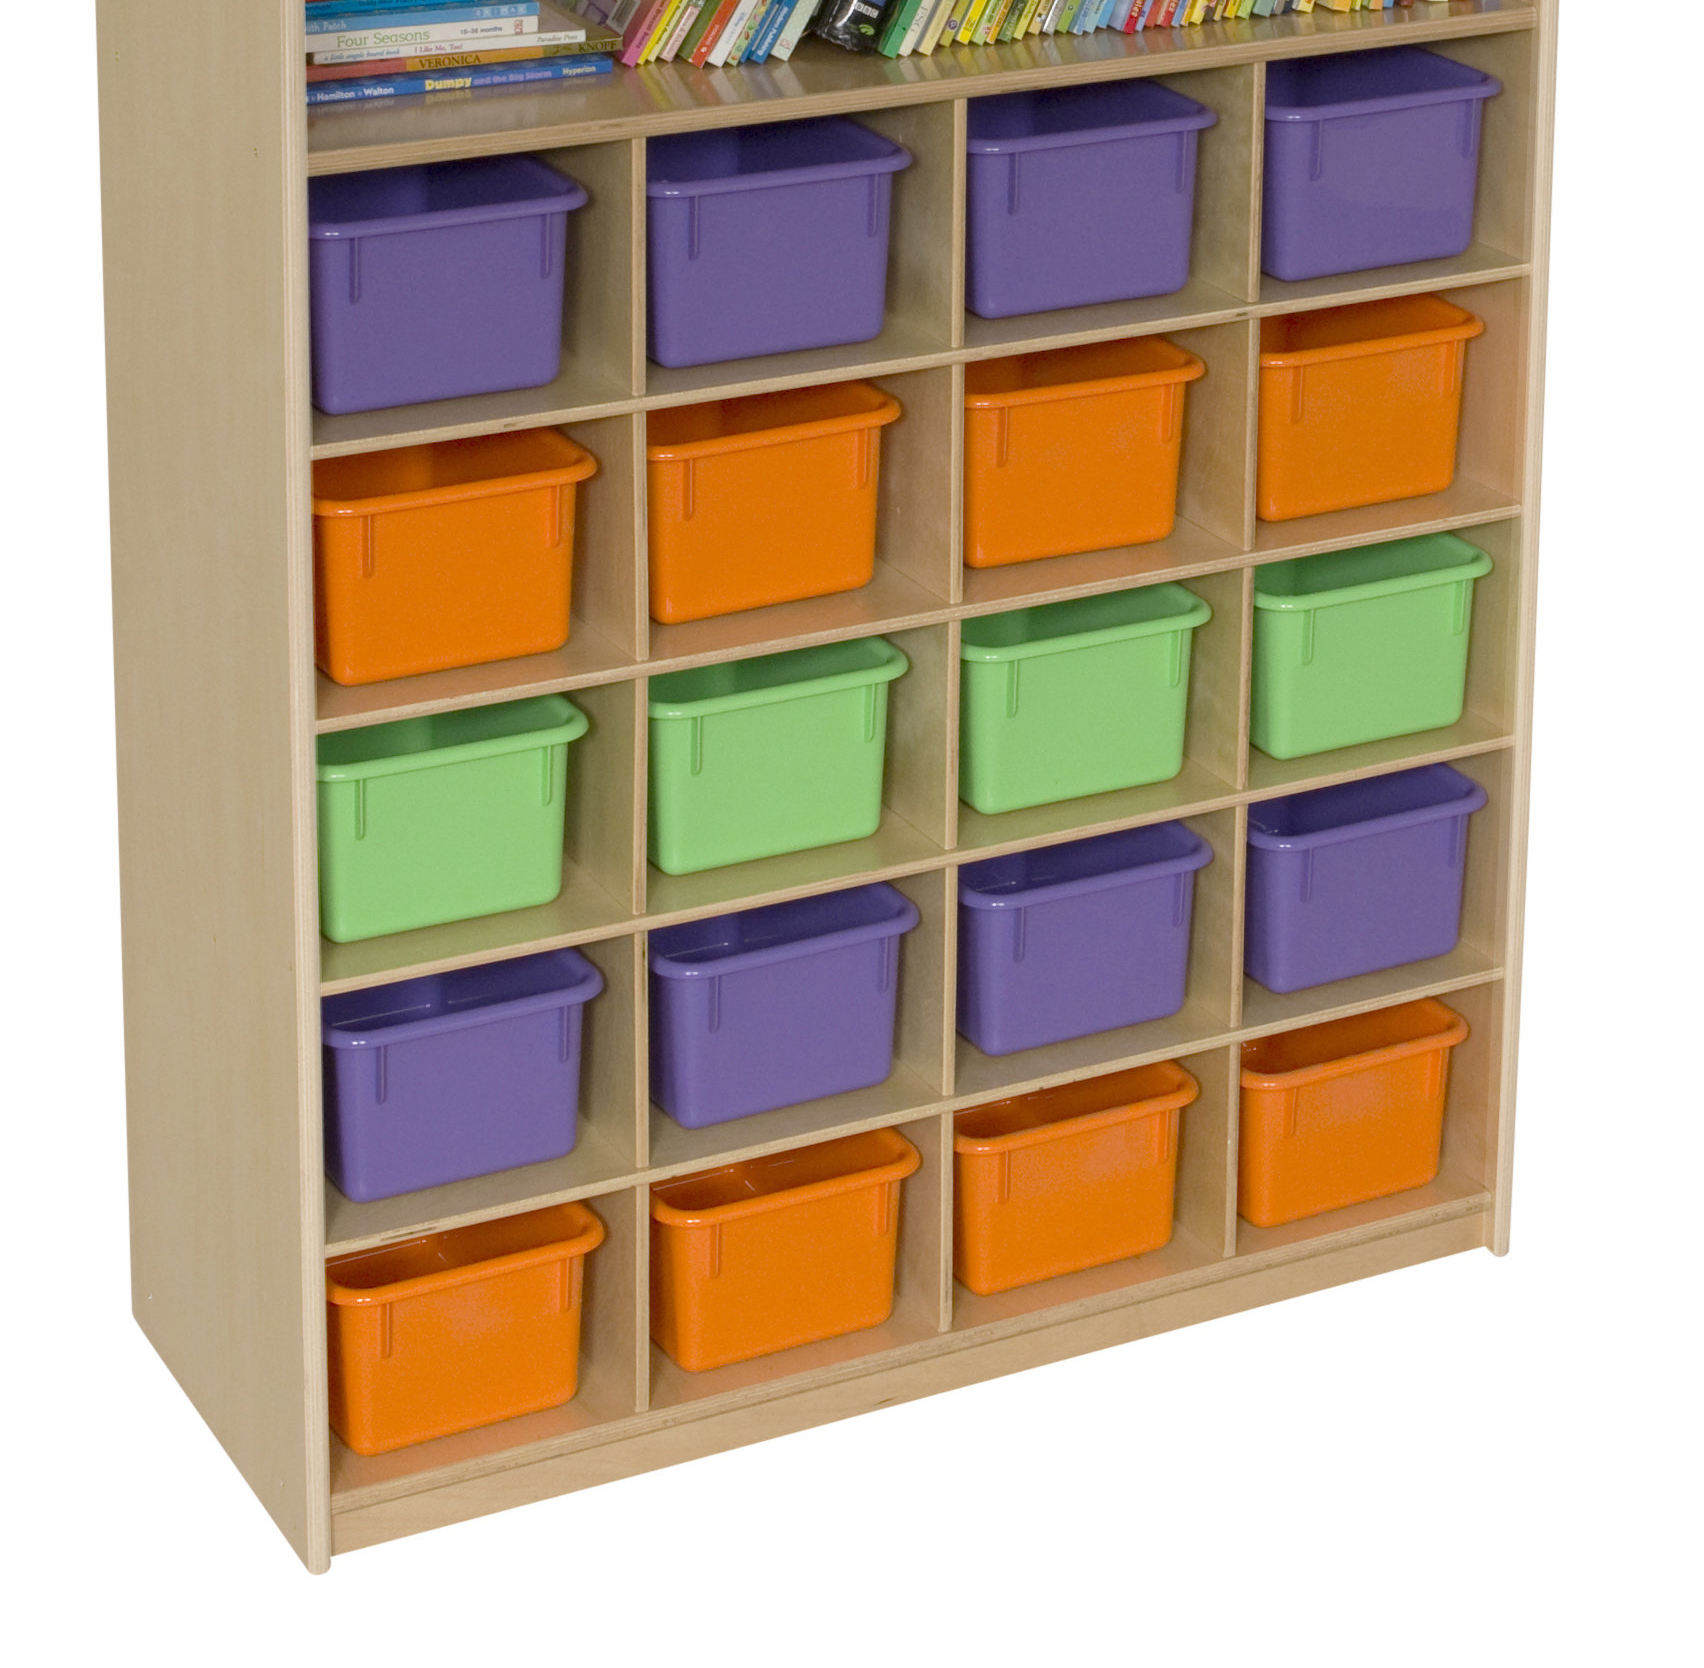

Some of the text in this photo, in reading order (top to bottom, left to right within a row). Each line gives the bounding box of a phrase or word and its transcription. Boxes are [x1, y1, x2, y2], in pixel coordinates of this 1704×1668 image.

[855, 3, 879, 19] BBC
[909, 5, 928, 33] FSG
[322, 19, 346, 30] Patch
[337, 31, 430, 48] Four Seasons
[577, 39, 617, 53] KNOPF
[756, 26, 777, 57] Publishing
[418, 53, 480, 69] VERONICA
[562, 65, 596, 75] Hyperion
[424, 70, 551, 90] Dumpy and the Big Storm
[316, 85, 394, 101] Hamilton Walton
